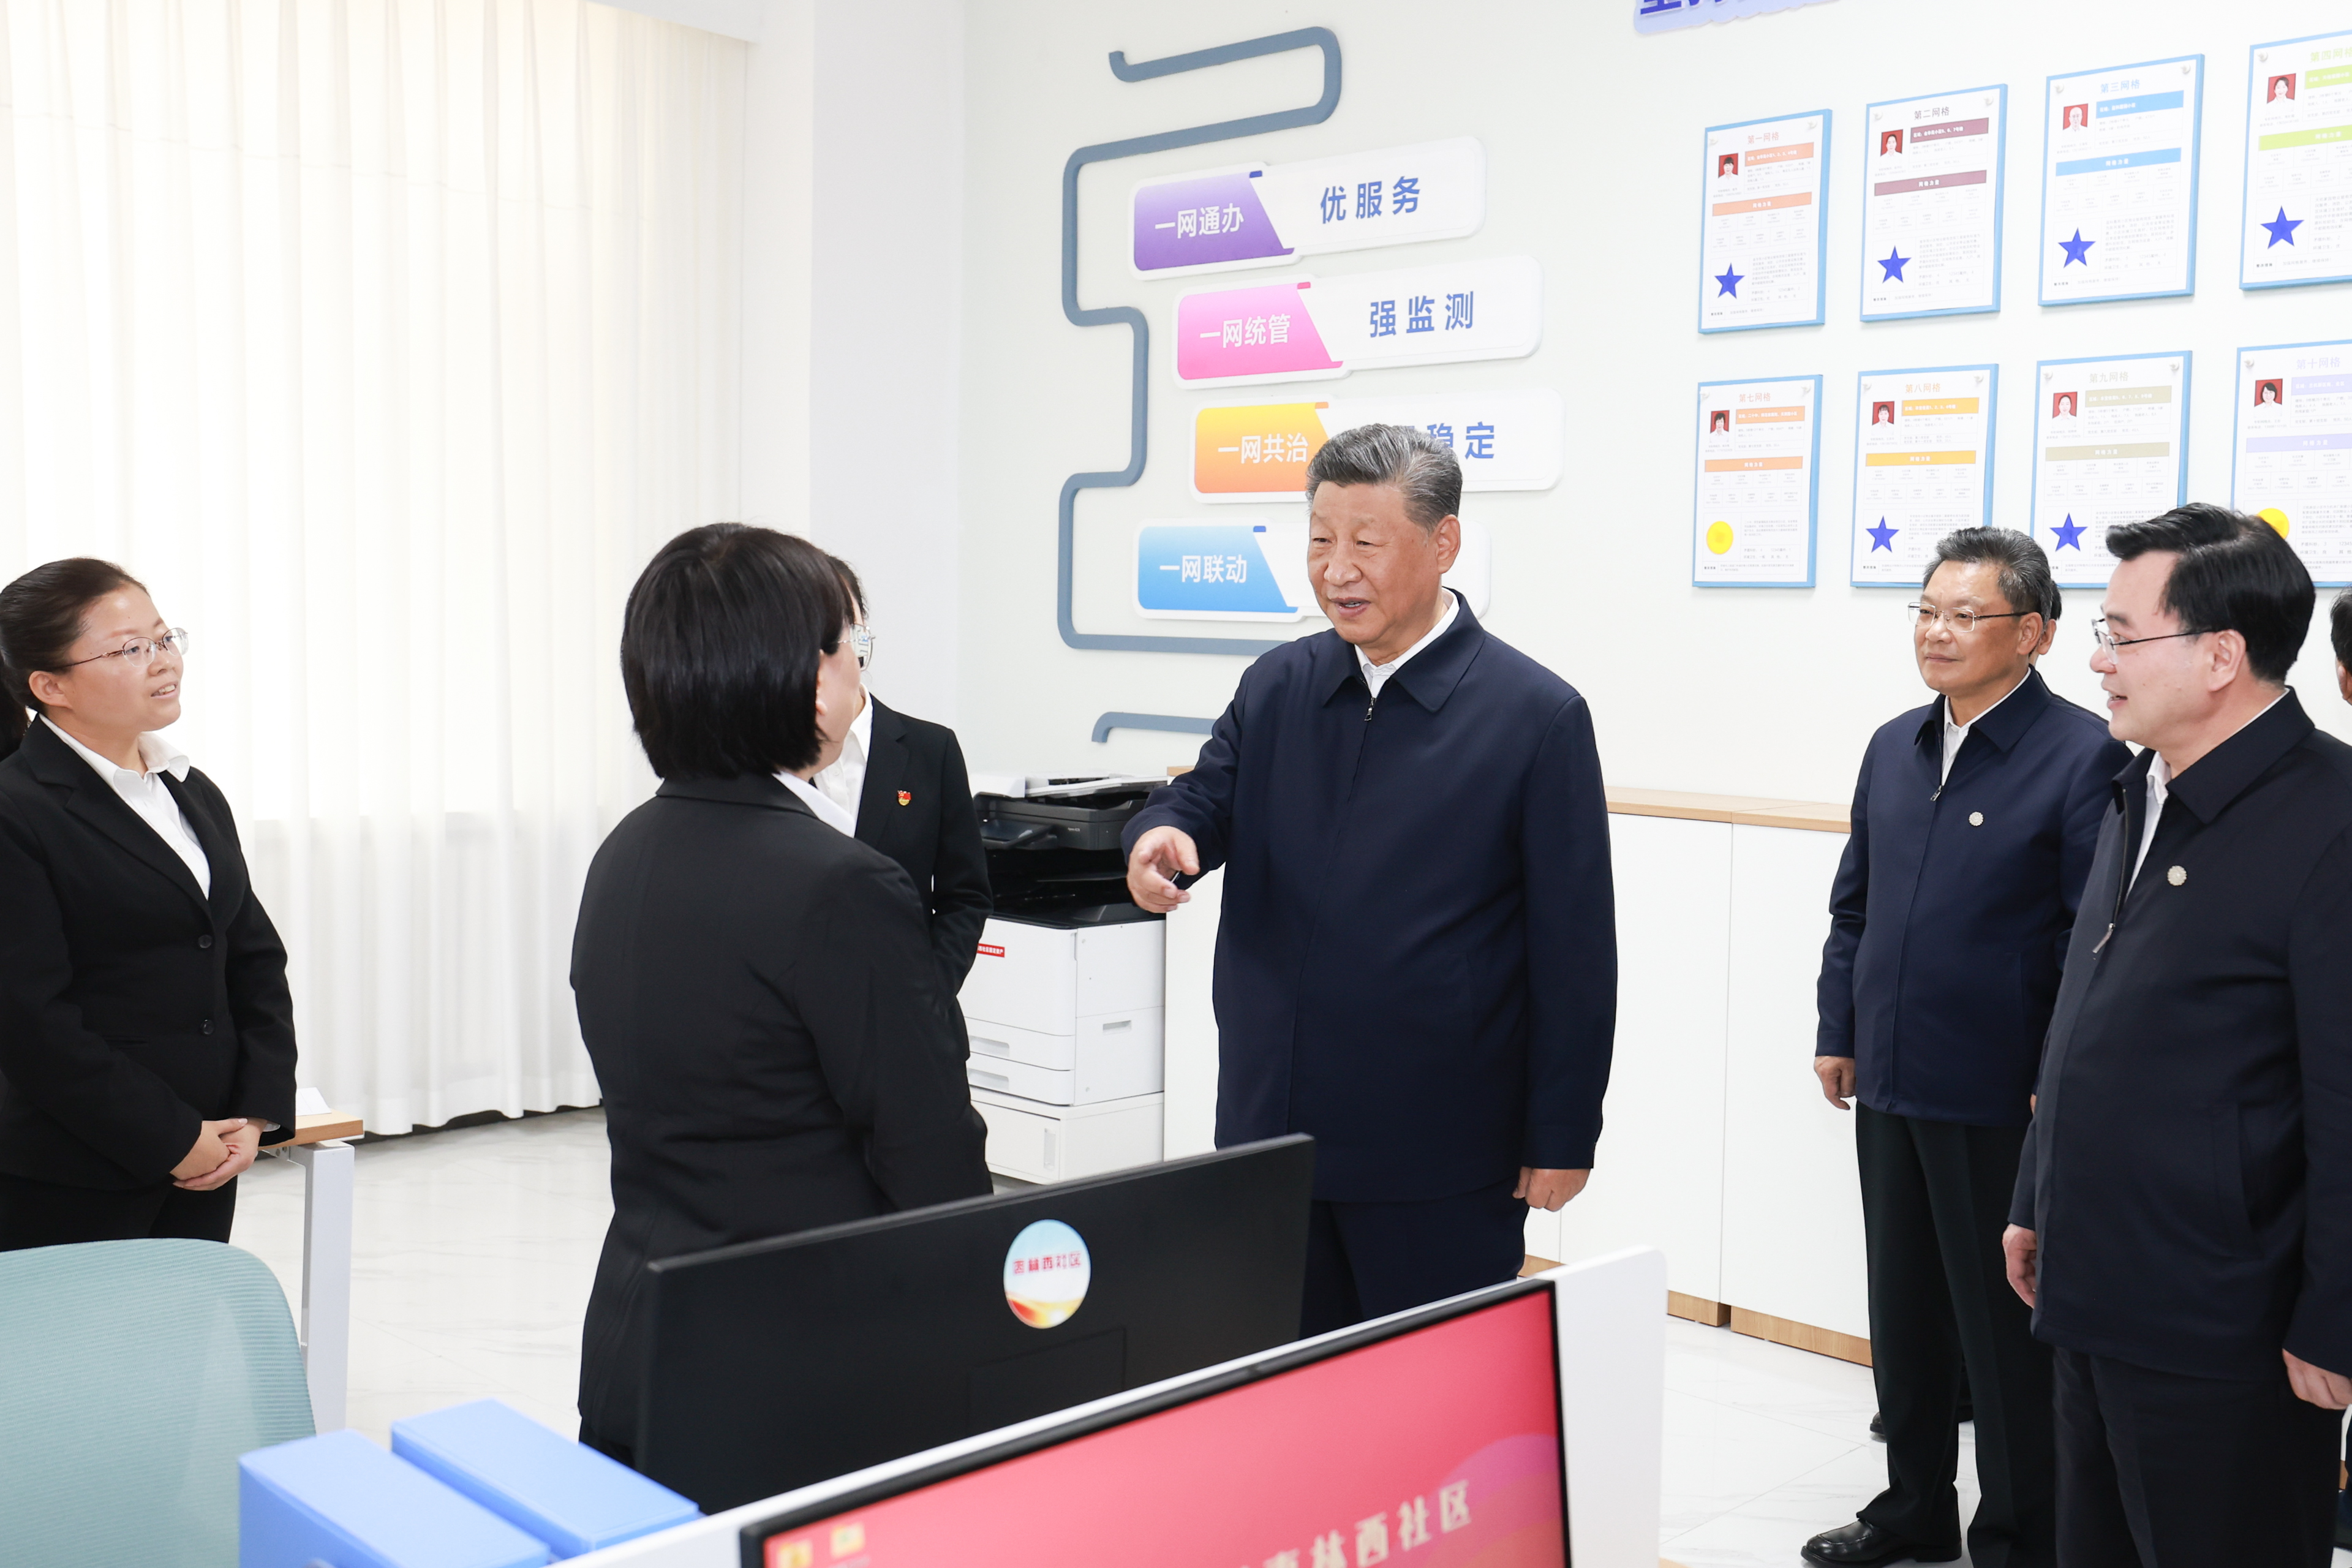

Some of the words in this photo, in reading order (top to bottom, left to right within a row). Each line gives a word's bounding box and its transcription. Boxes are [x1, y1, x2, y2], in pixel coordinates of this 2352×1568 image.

[2310, 47, 2352, 62] 第四网格
[2100, 79, 2140, 94] 第三网格
[1914, 106, 1950, 120] 第二网格
[1747, 132, 1779, 145] 第一网格
[1321, 176, 1420, 224] 优服务
[1155, 203, 1245, 239] 一网通办
[1370, 291, 1474, 338] 强监测
[1199, 314, 1291, 348] 一网统管
[2296, 356, 2340, 370] 第十网格
[2089, 371, 2129, 383] 第九网格
[1905, 383, 1941, 394] 第八网格
[1739, 392, 1771, 403] 第七网格
[1407, 421, 1495, 459] 稳定
[1218, 432, 1309, 464] 一网共治
[1159, 554, 1247, 583] 一网联动
